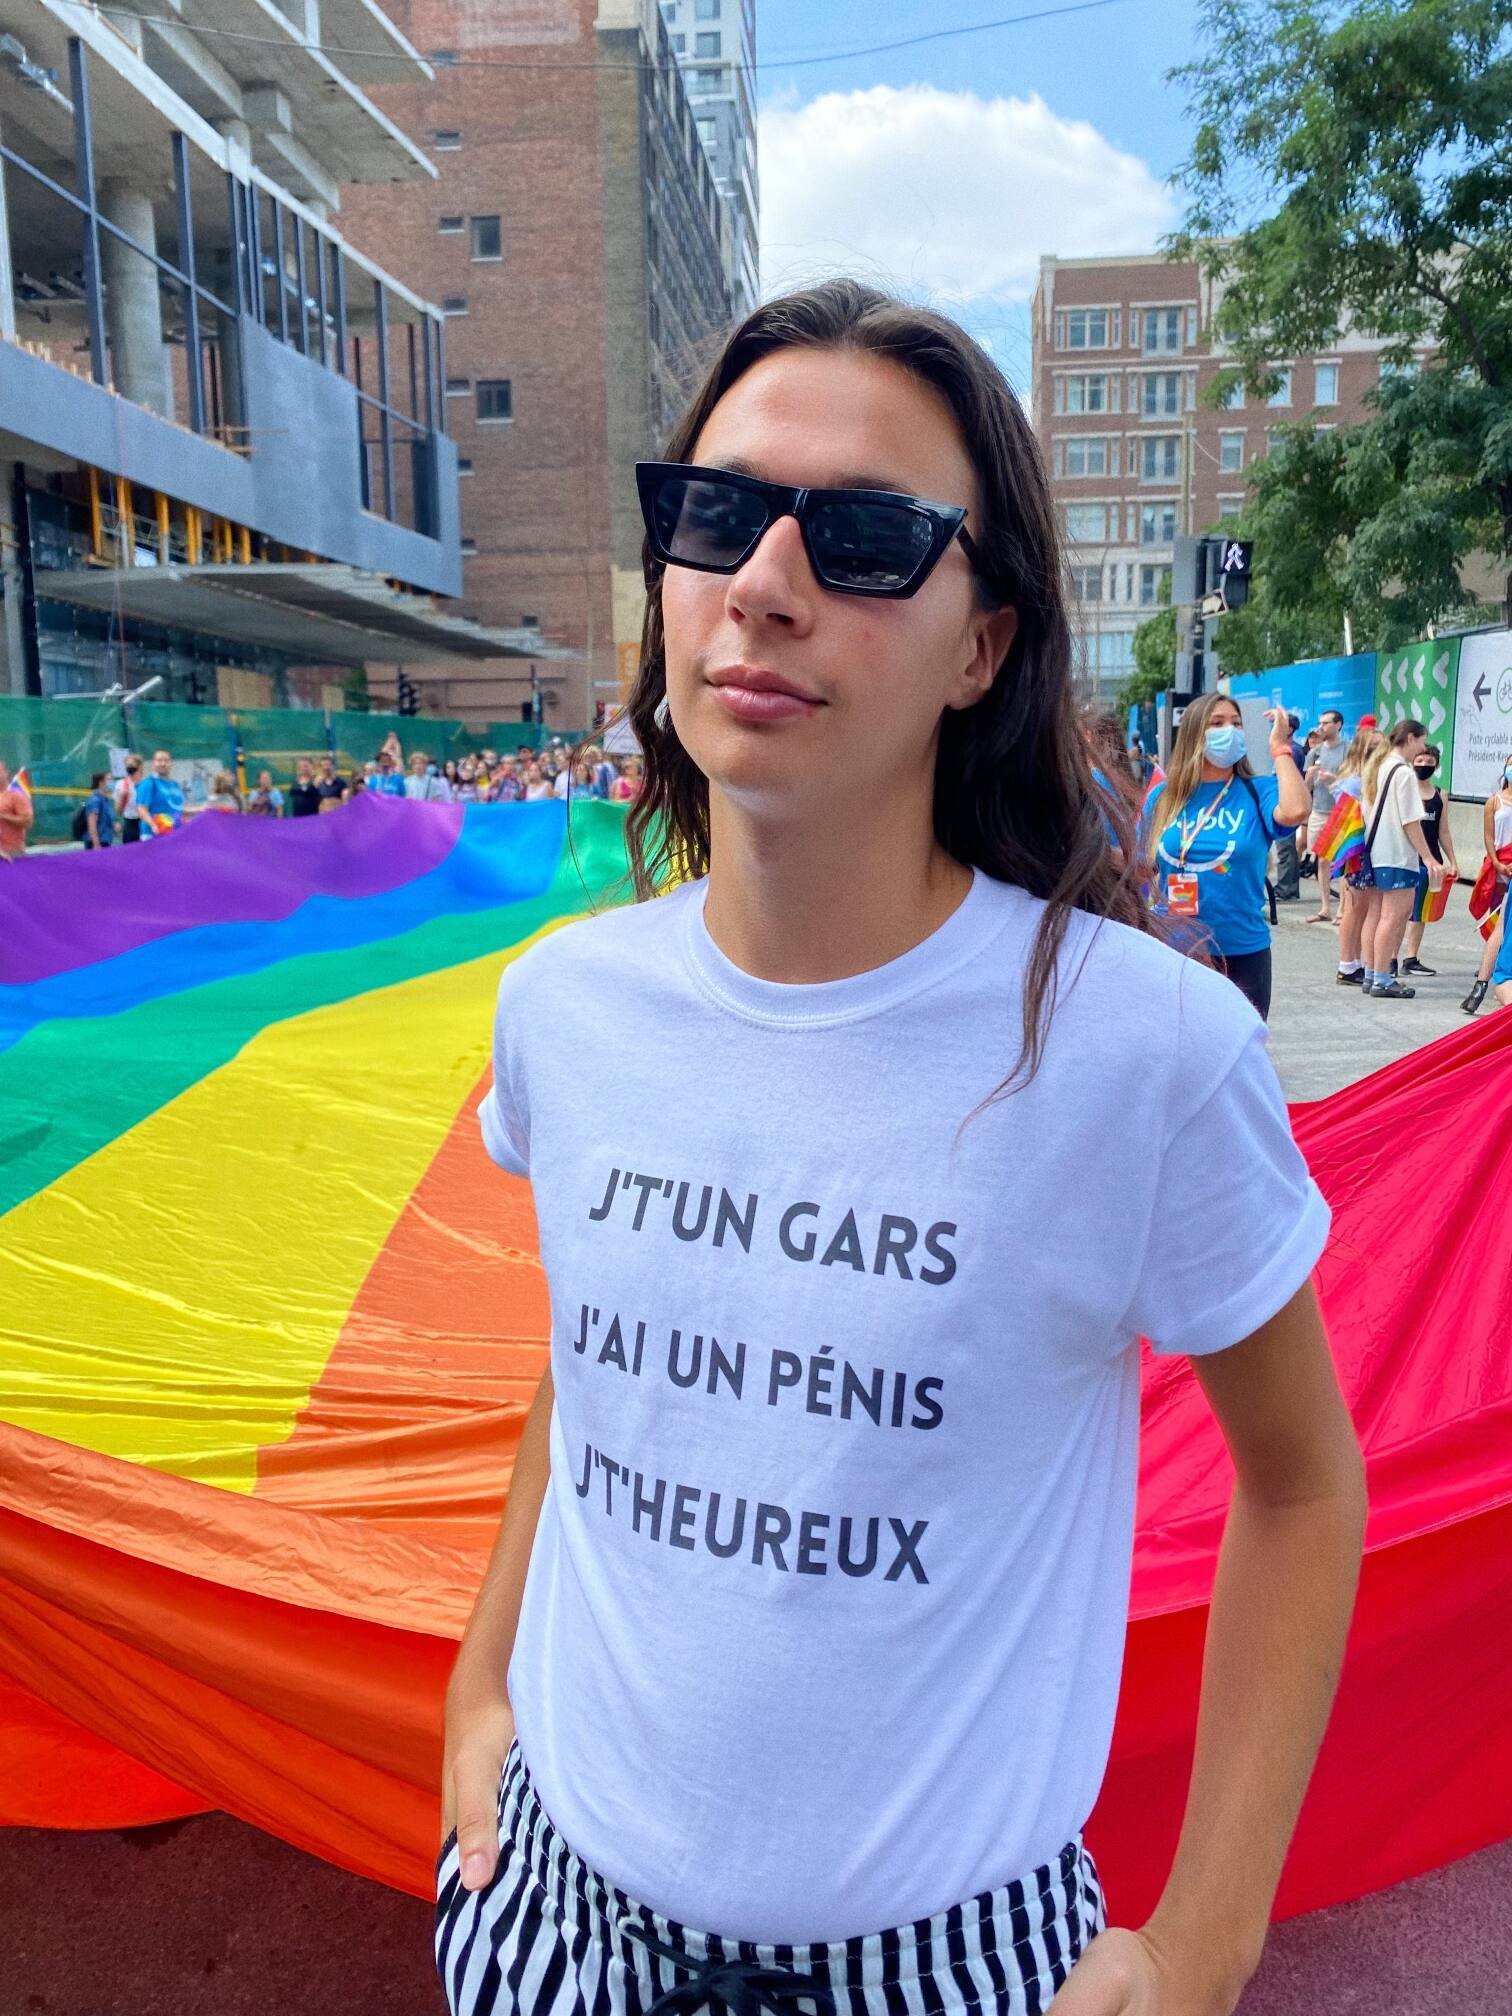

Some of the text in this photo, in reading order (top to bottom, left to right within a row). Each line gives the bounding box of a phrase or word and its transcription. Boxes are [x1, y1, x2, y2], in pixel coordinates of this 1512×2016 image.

[1484, 732, 1509, 748] cyclable
[588, 1167, 958, 1286] J'T'UN GARS
[573, 1303, 945, 1431] J'AI UN PÉNIS
[575, 1443, 930, 1585] J'T'HEUREUX
